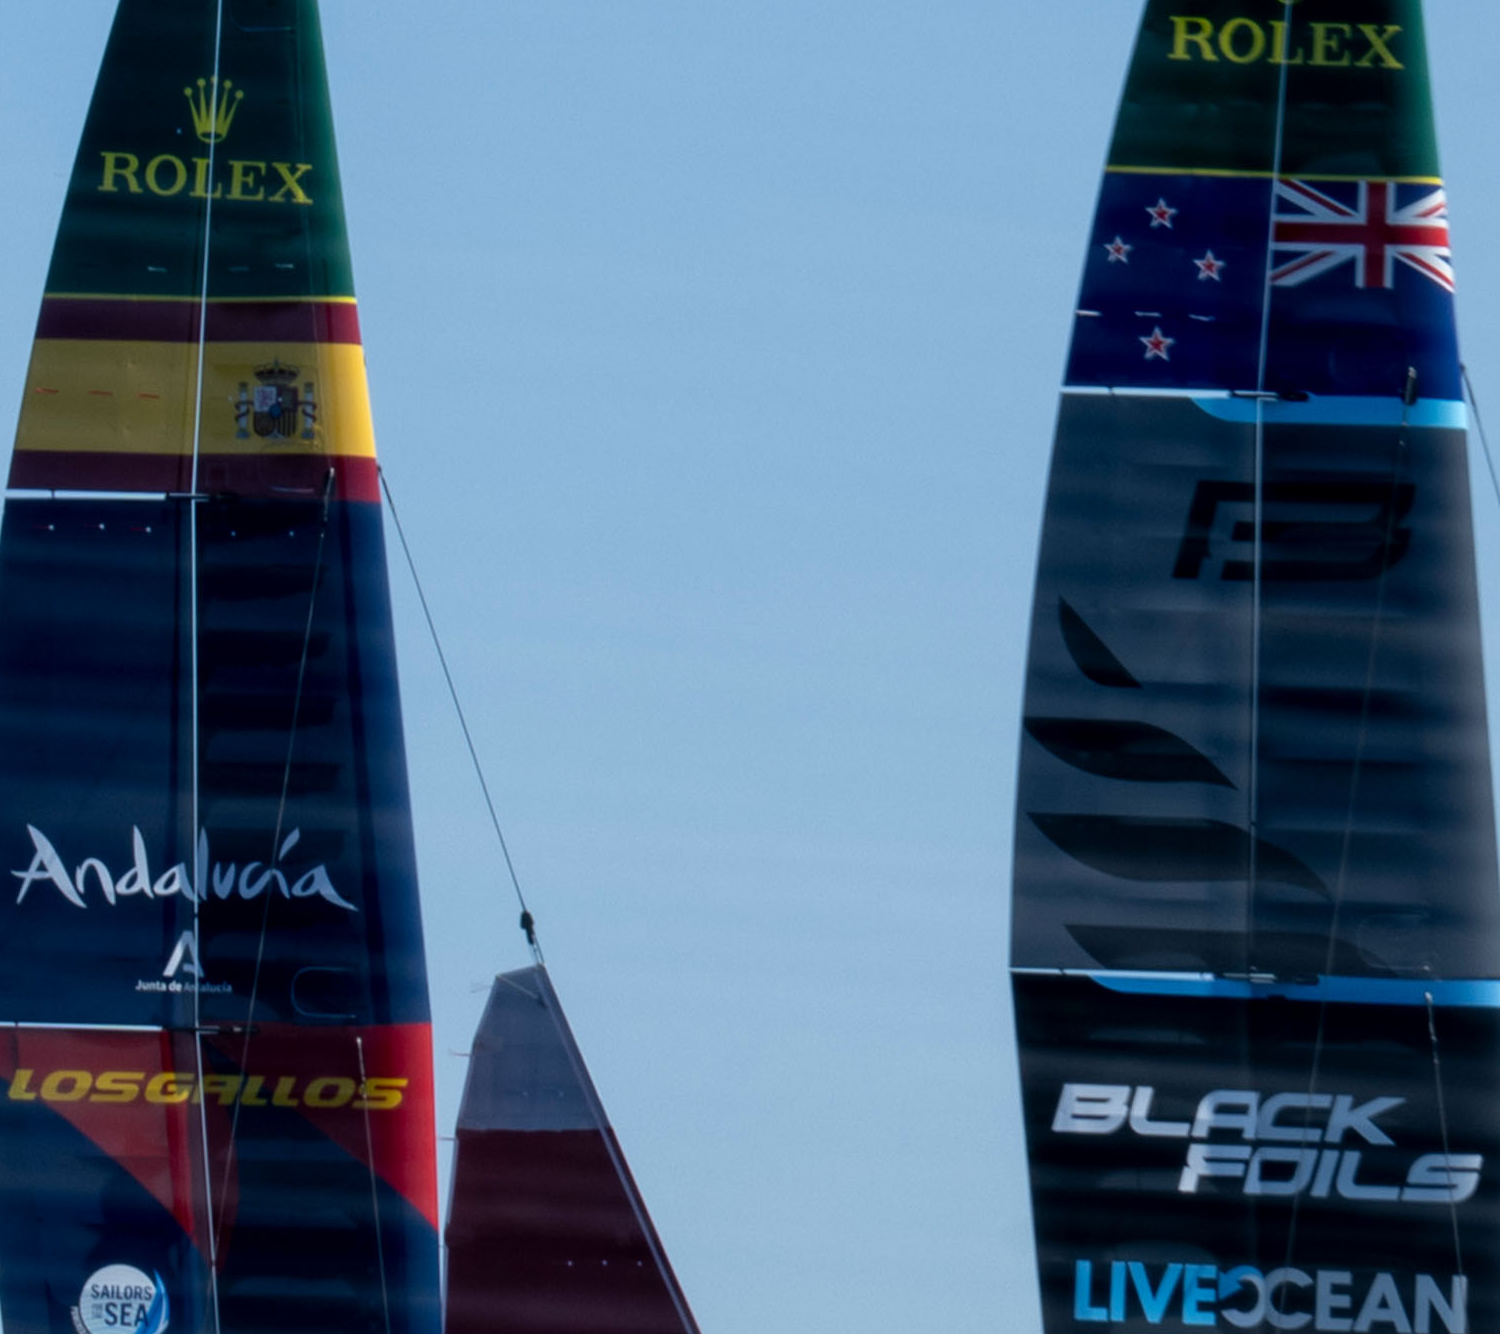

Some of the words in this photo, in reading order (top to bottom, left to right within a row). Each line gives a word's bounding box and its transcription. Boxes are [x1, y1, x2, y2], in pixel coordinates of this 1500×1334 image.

[1166, 15, 1405, 69] ROLEX
[96, 150, 315, 205] ROLEX
[11, 822, 359, 912] Andalucía
[183, 980, 232, 993] Analucía
[1051, 1082, 1406, 1147] BLACK
[1177, 1142, 1483, 1203] FOILS
[90, 1283, 153, 1301] SAILORS
[103, 1301, 150, 1327] SEA
